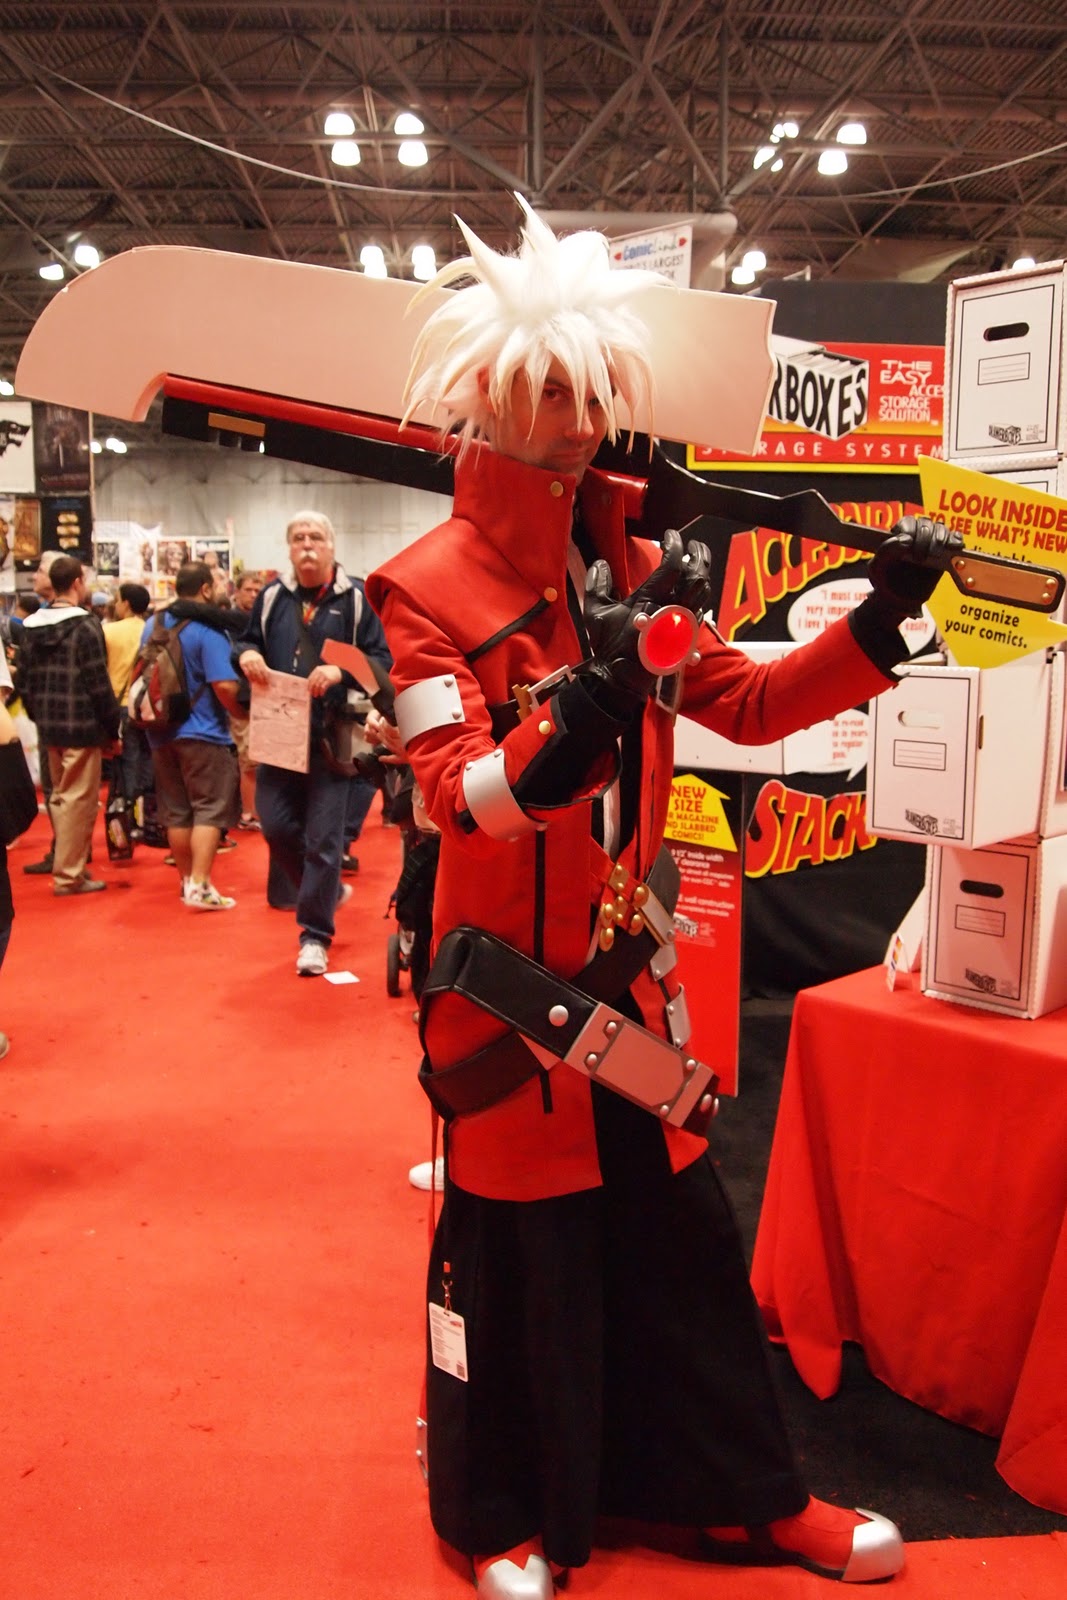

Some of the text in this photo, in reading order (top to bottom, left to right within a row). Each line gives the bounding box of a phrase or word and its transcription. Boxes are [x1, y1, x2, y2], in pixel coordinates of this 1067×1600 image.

[881, 359, 932, 371] THE
[880, 370, 932, 385] EASY
[909, 384, 945, 398] ACCE
[880, 396, 930, 409] STORAGE
[879, 408, 931, 422] SOLUTION
[702, 442, 823, 456] SRAGE
[939, 489, 1067, 533] LOOK INSIDE
[949, 515, 973, 536] SEE
[976, 520, 1031, 547] WHAT'S
[1033, 531, 1067, 554] NEW
[960, 604, 1020, 627] organize
[945, 619, 1028, 649] your comics.
[672, 785, 707, 800] NEW
[674, 799, 703, 813] SIZE
[677, 812, 719, 824] MAGAZINE
[681, 822, 716, 833] SLABBED
